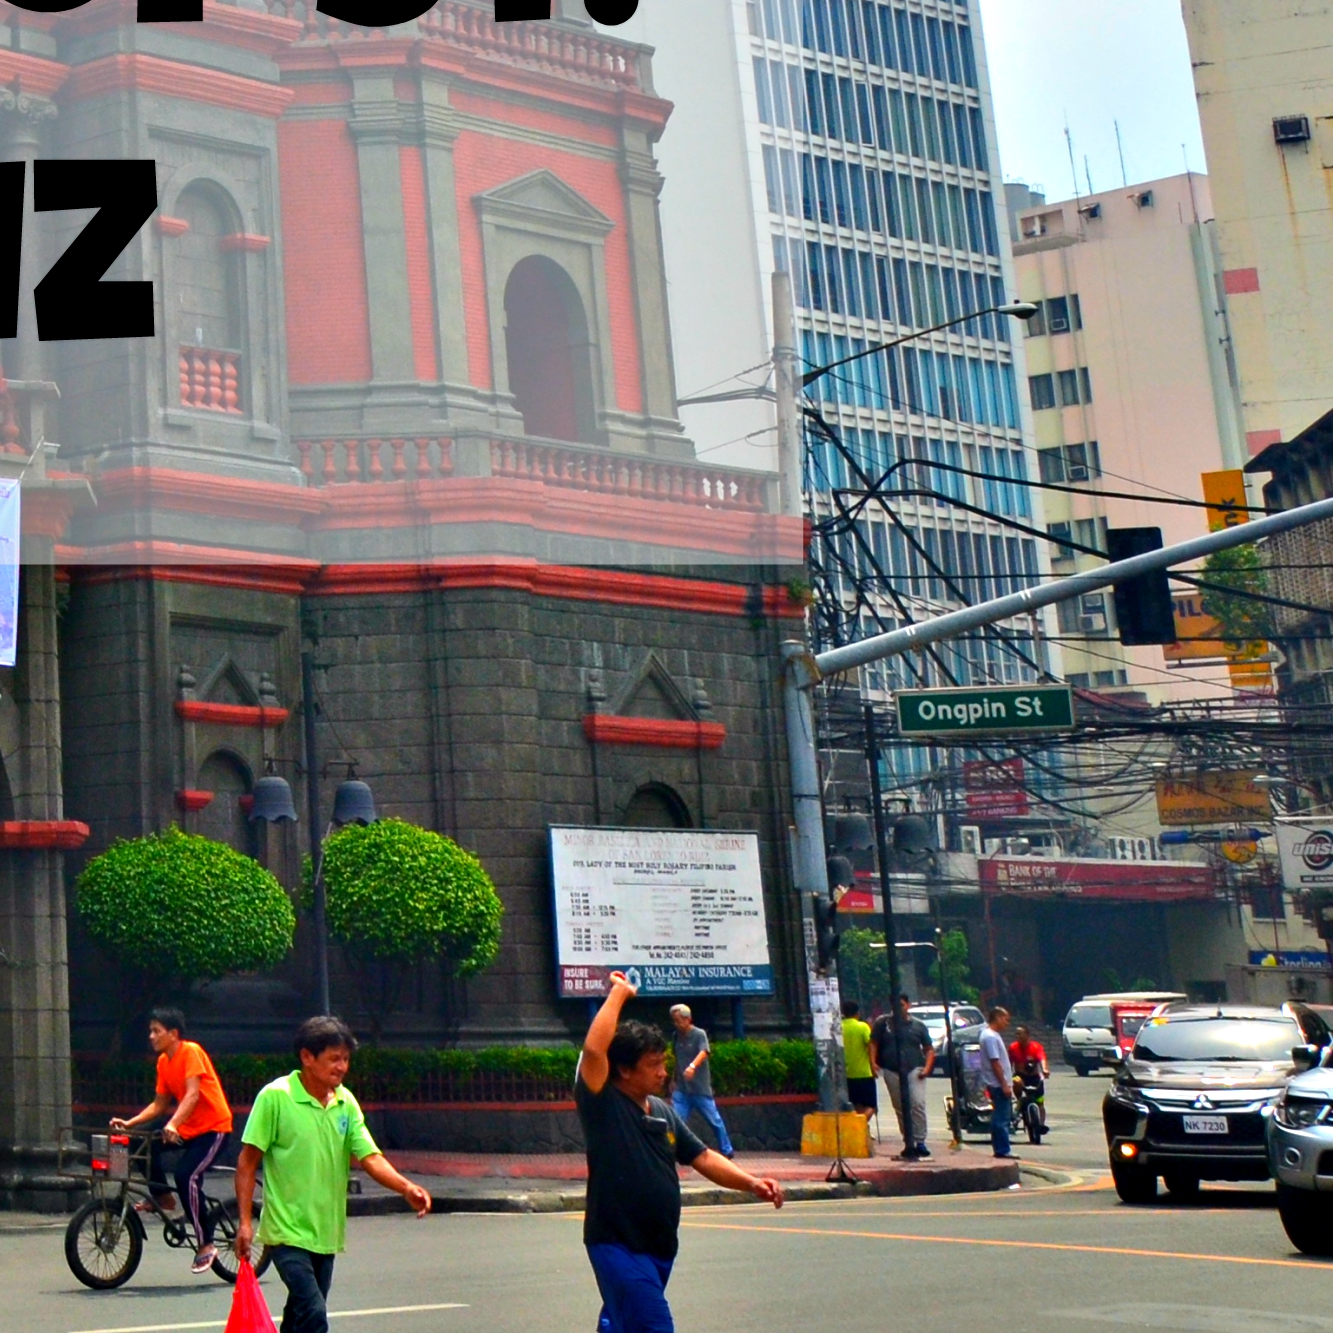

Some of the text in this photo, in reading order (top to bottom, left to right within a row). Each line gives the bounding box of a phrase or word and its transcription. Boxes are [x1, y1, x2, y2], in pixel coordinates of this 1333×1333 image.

[918, 696, 1043, 725] Ongpin St
[1009, 864, 1057, 877] BANK OF THE
[564, 967, 588, 978] INSURE
[644, 967, 753, 978] MALAYAN INSURANCE
[564, 980, 573, 990] TO
[574, 980, 583, 990] BE
[1185, 1121, 1226, 1132] NK 7230
